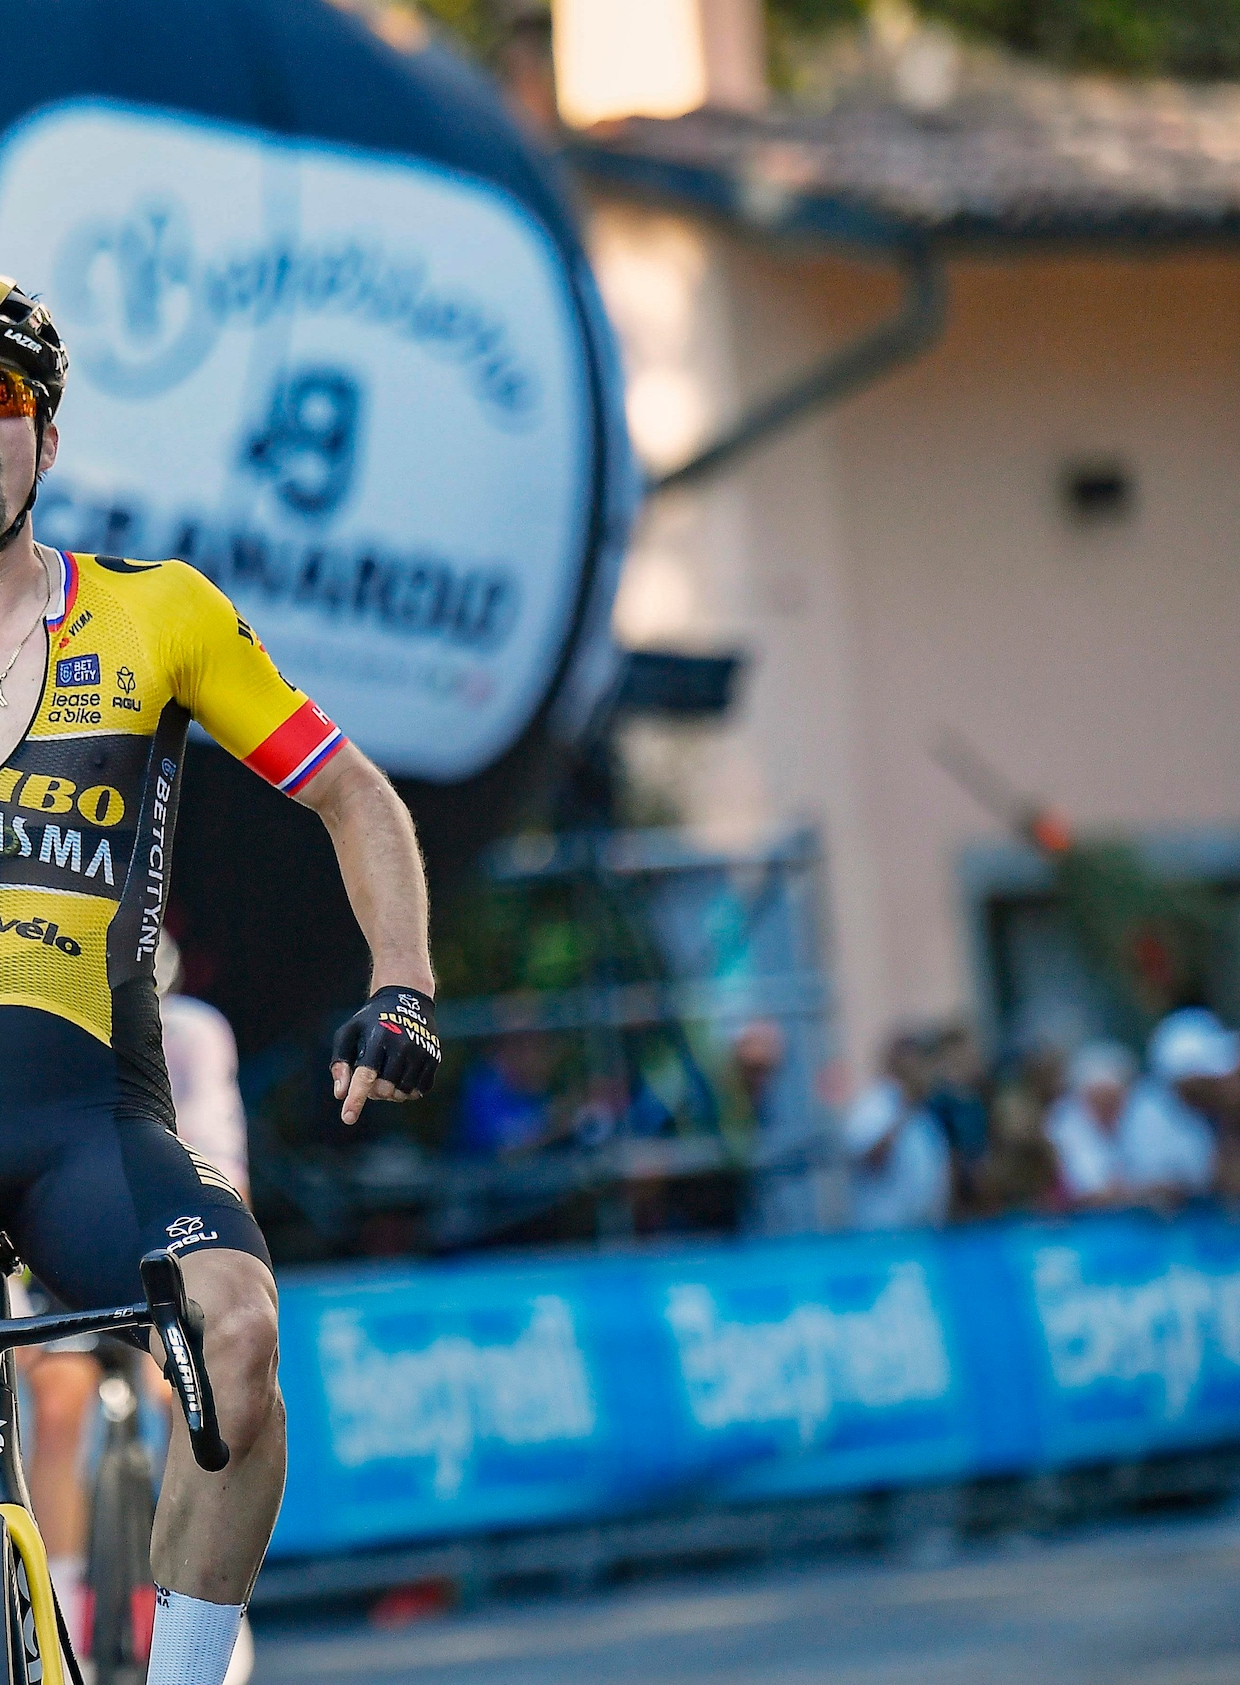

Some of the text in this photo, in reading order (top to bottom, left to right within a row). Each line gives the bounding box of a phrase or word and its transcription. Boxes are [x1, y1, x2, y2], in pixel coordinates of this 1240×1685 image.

[3, 328, 43, 354] LAZER
[68, 609, 94, 637] VISMA
[73, 659, 93, 671] BET
[73, 669, 97, 682] CITY
[51, 692, 101, 707] lease
[112, 696, 141, 712] AGU
[48, 707, 102, 724] a bike
[136, 775, 171, 962] BETCITY.NL
[378, 1012, 441, 1049] JUMBO
[405, 1028, 442, 1063] VISMA
[166, 1231, 218, 1253] AGU
[165, 1326, 201, 1412] SRAM
